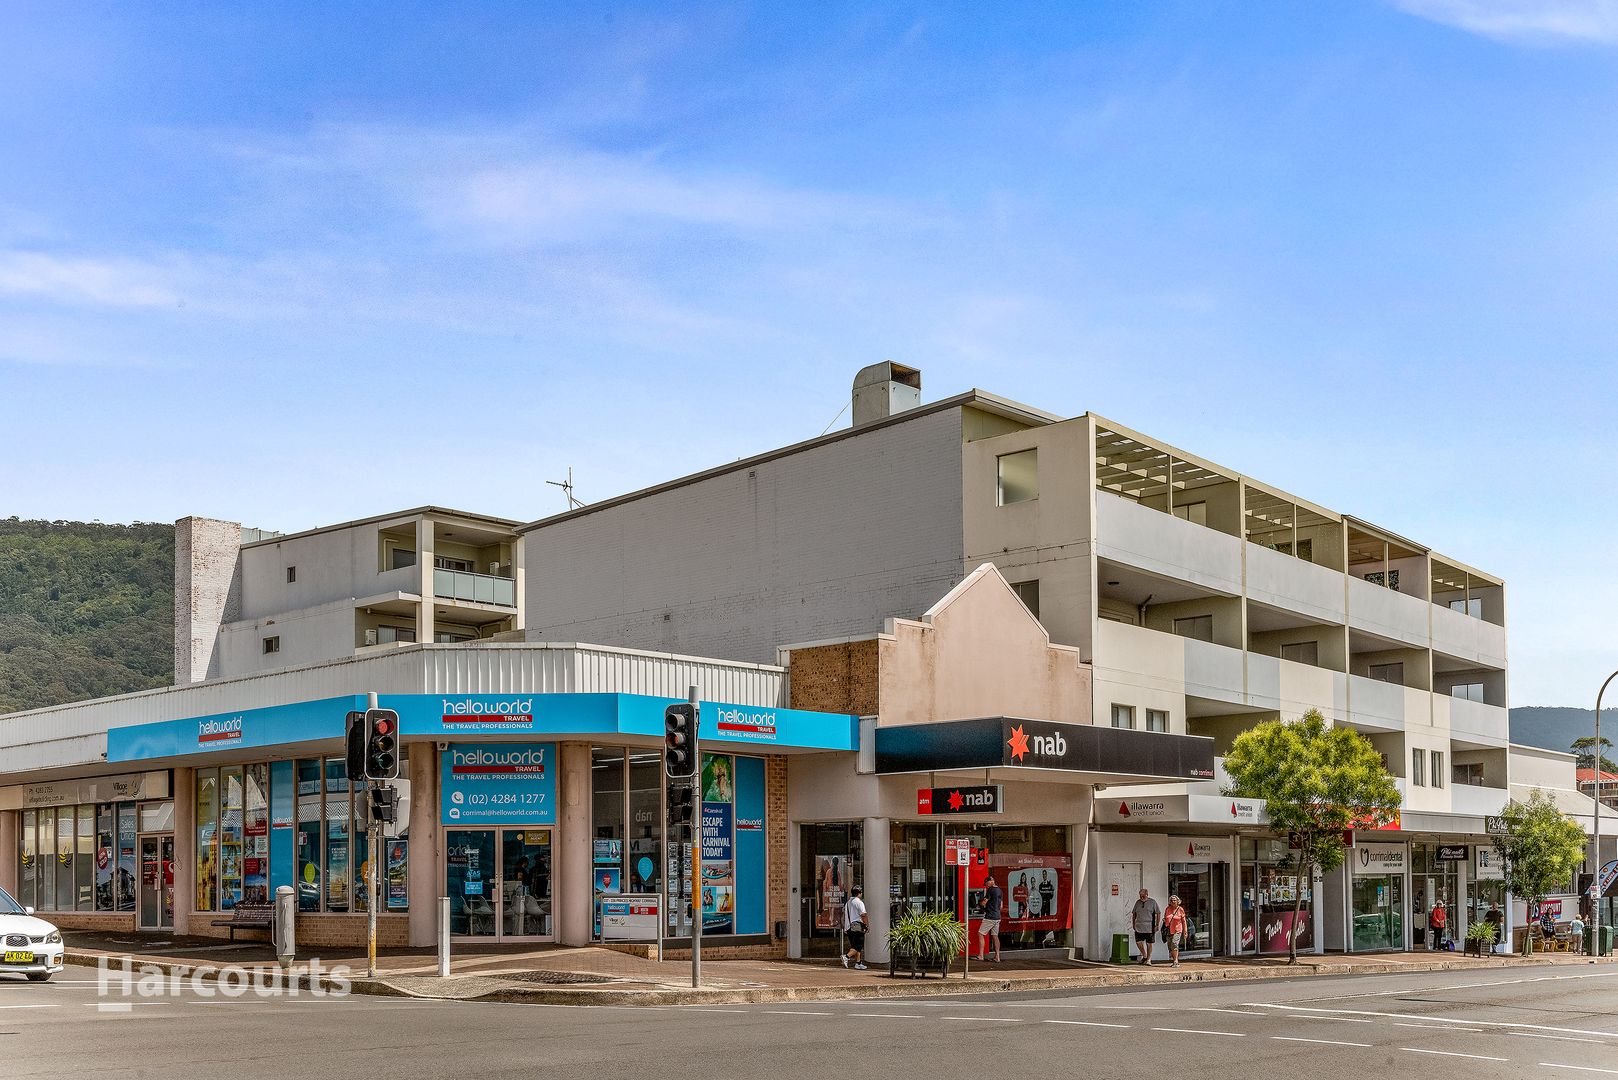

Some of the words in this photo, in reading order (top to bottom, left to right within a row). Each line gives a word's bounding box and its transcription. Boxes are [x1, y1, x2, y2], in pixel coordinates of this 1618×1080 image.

[442, 699, 533, 714] helloworld
[717, 707, 776, 725] helloworld
[199, 716, 242, 735] helloworld
[743, 732, 777, 740] PROFESSIONALS
[1033, 731, 1067, 757] nab
[452, 749, 545, 765] helloworld
[112, 782, 128, 792] Village
[468, 794, 488, 805] (02)
[490, 794, 517, 804] 4284
[520, 794, 546, 804] 1277
[965, 789, 994, 806] nab
[1131, 802, 1164, 811] illawarra
[1237, 803, 1253, 812] illawarra
[462, 808, 548, 817] corrimal@helloworld.com.au
[120, 819, 134, 829] Sales
[702, 817, 723, 827] ESCAPE
[702, 827, 719, 837] WITH
[702, 837, 731, 847] CARNIVAL
[702, 847, 723, 857] TODAY!
[1265, 919, 1283, 941] Tasty
